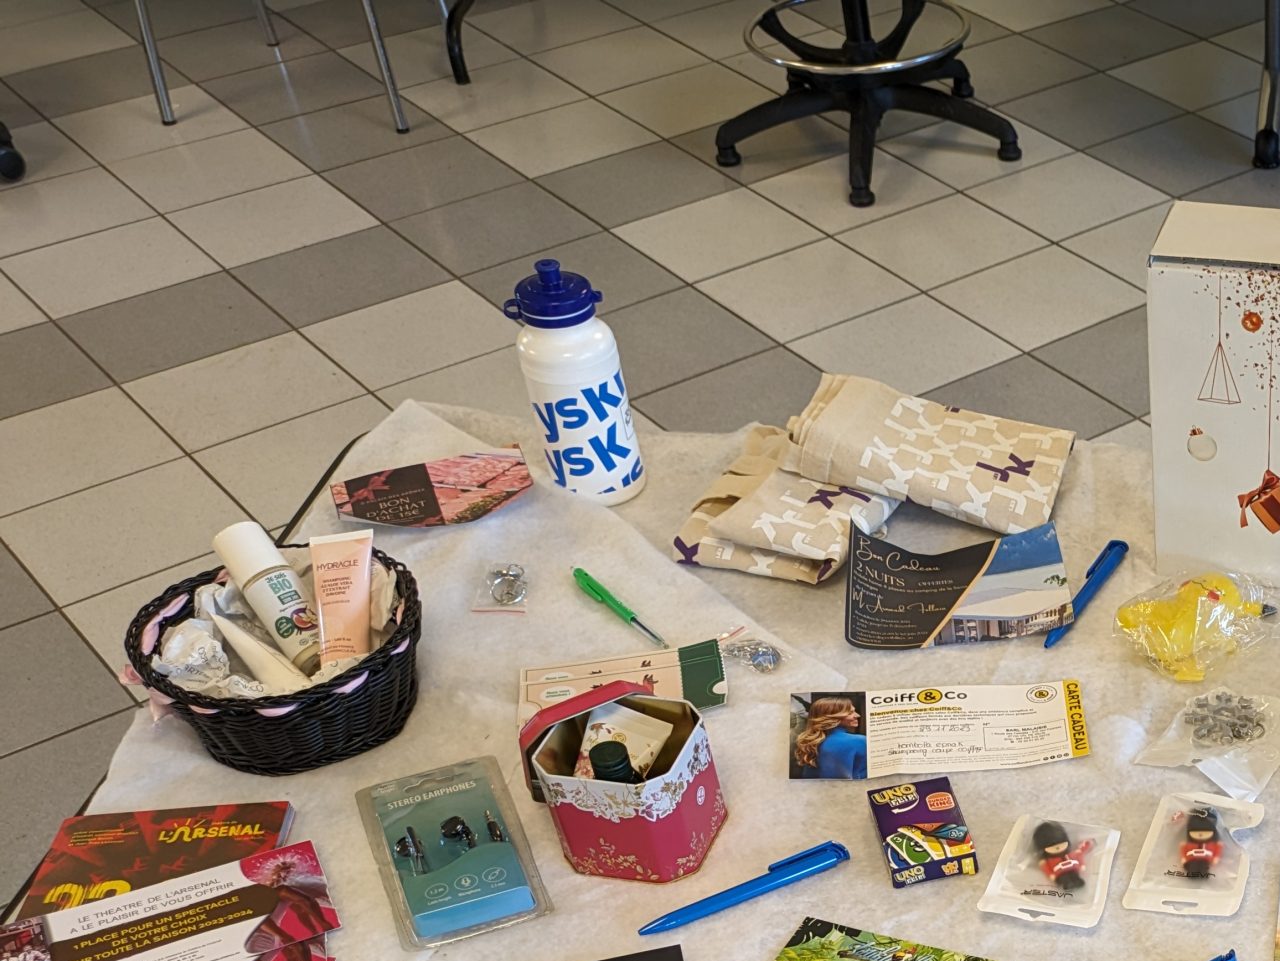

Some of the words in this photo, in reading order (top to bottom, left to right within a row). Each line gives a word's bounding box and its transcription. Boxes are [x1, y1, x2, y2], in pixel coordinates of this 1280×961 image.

[366, 501, 426, 518] D'ACHAT
[379, 497, 410, 510] BON
[268, 579, 293, 595] BIO
[865, 565, 906, 587] NUITS
[1066, 682, 1082, 711] CARTE
[1070, 712, 1088, 751] CADEAU
[387, 795, 421, 810] STEREO
[423, 780, 477, 801] EARPHONES
[871, 784, 917, 805] UNO
[929, 800, 953, 808] KING
[895, 866, 924, 882] UNO
[78, 915, 90, 923] LE
[94, 901, 143, 919] THEATRE
[147, 895, 161, 904] DE
[165, 878, 221, 899] L'ARSENAL
[82, 922, 96, 931] LE
[98, 909, 139, 927] PLAISIR
[143, 904, 158, 914] DE
[160, 895, 193, 909] VOUS
[195, 881, 235, 899] OFFRIR
[80, 931, 120, 949] PLACE
[121, 922, 153, 938] POUR
[155, 916, 173, 926] UN
[174, 895, 240, 920] SPECTACLE
[94, 944, 133, 961] TOUTE
[135, 938, 151, 948] LA
[153, 925, 197, 943] SAISON
[198, 909, 254, 930] 2023-2024
[112, 938, 128, 947] DE
[130, 926, 168, 944] VOTRE
[170, 913, 208, 930] CHOIX
